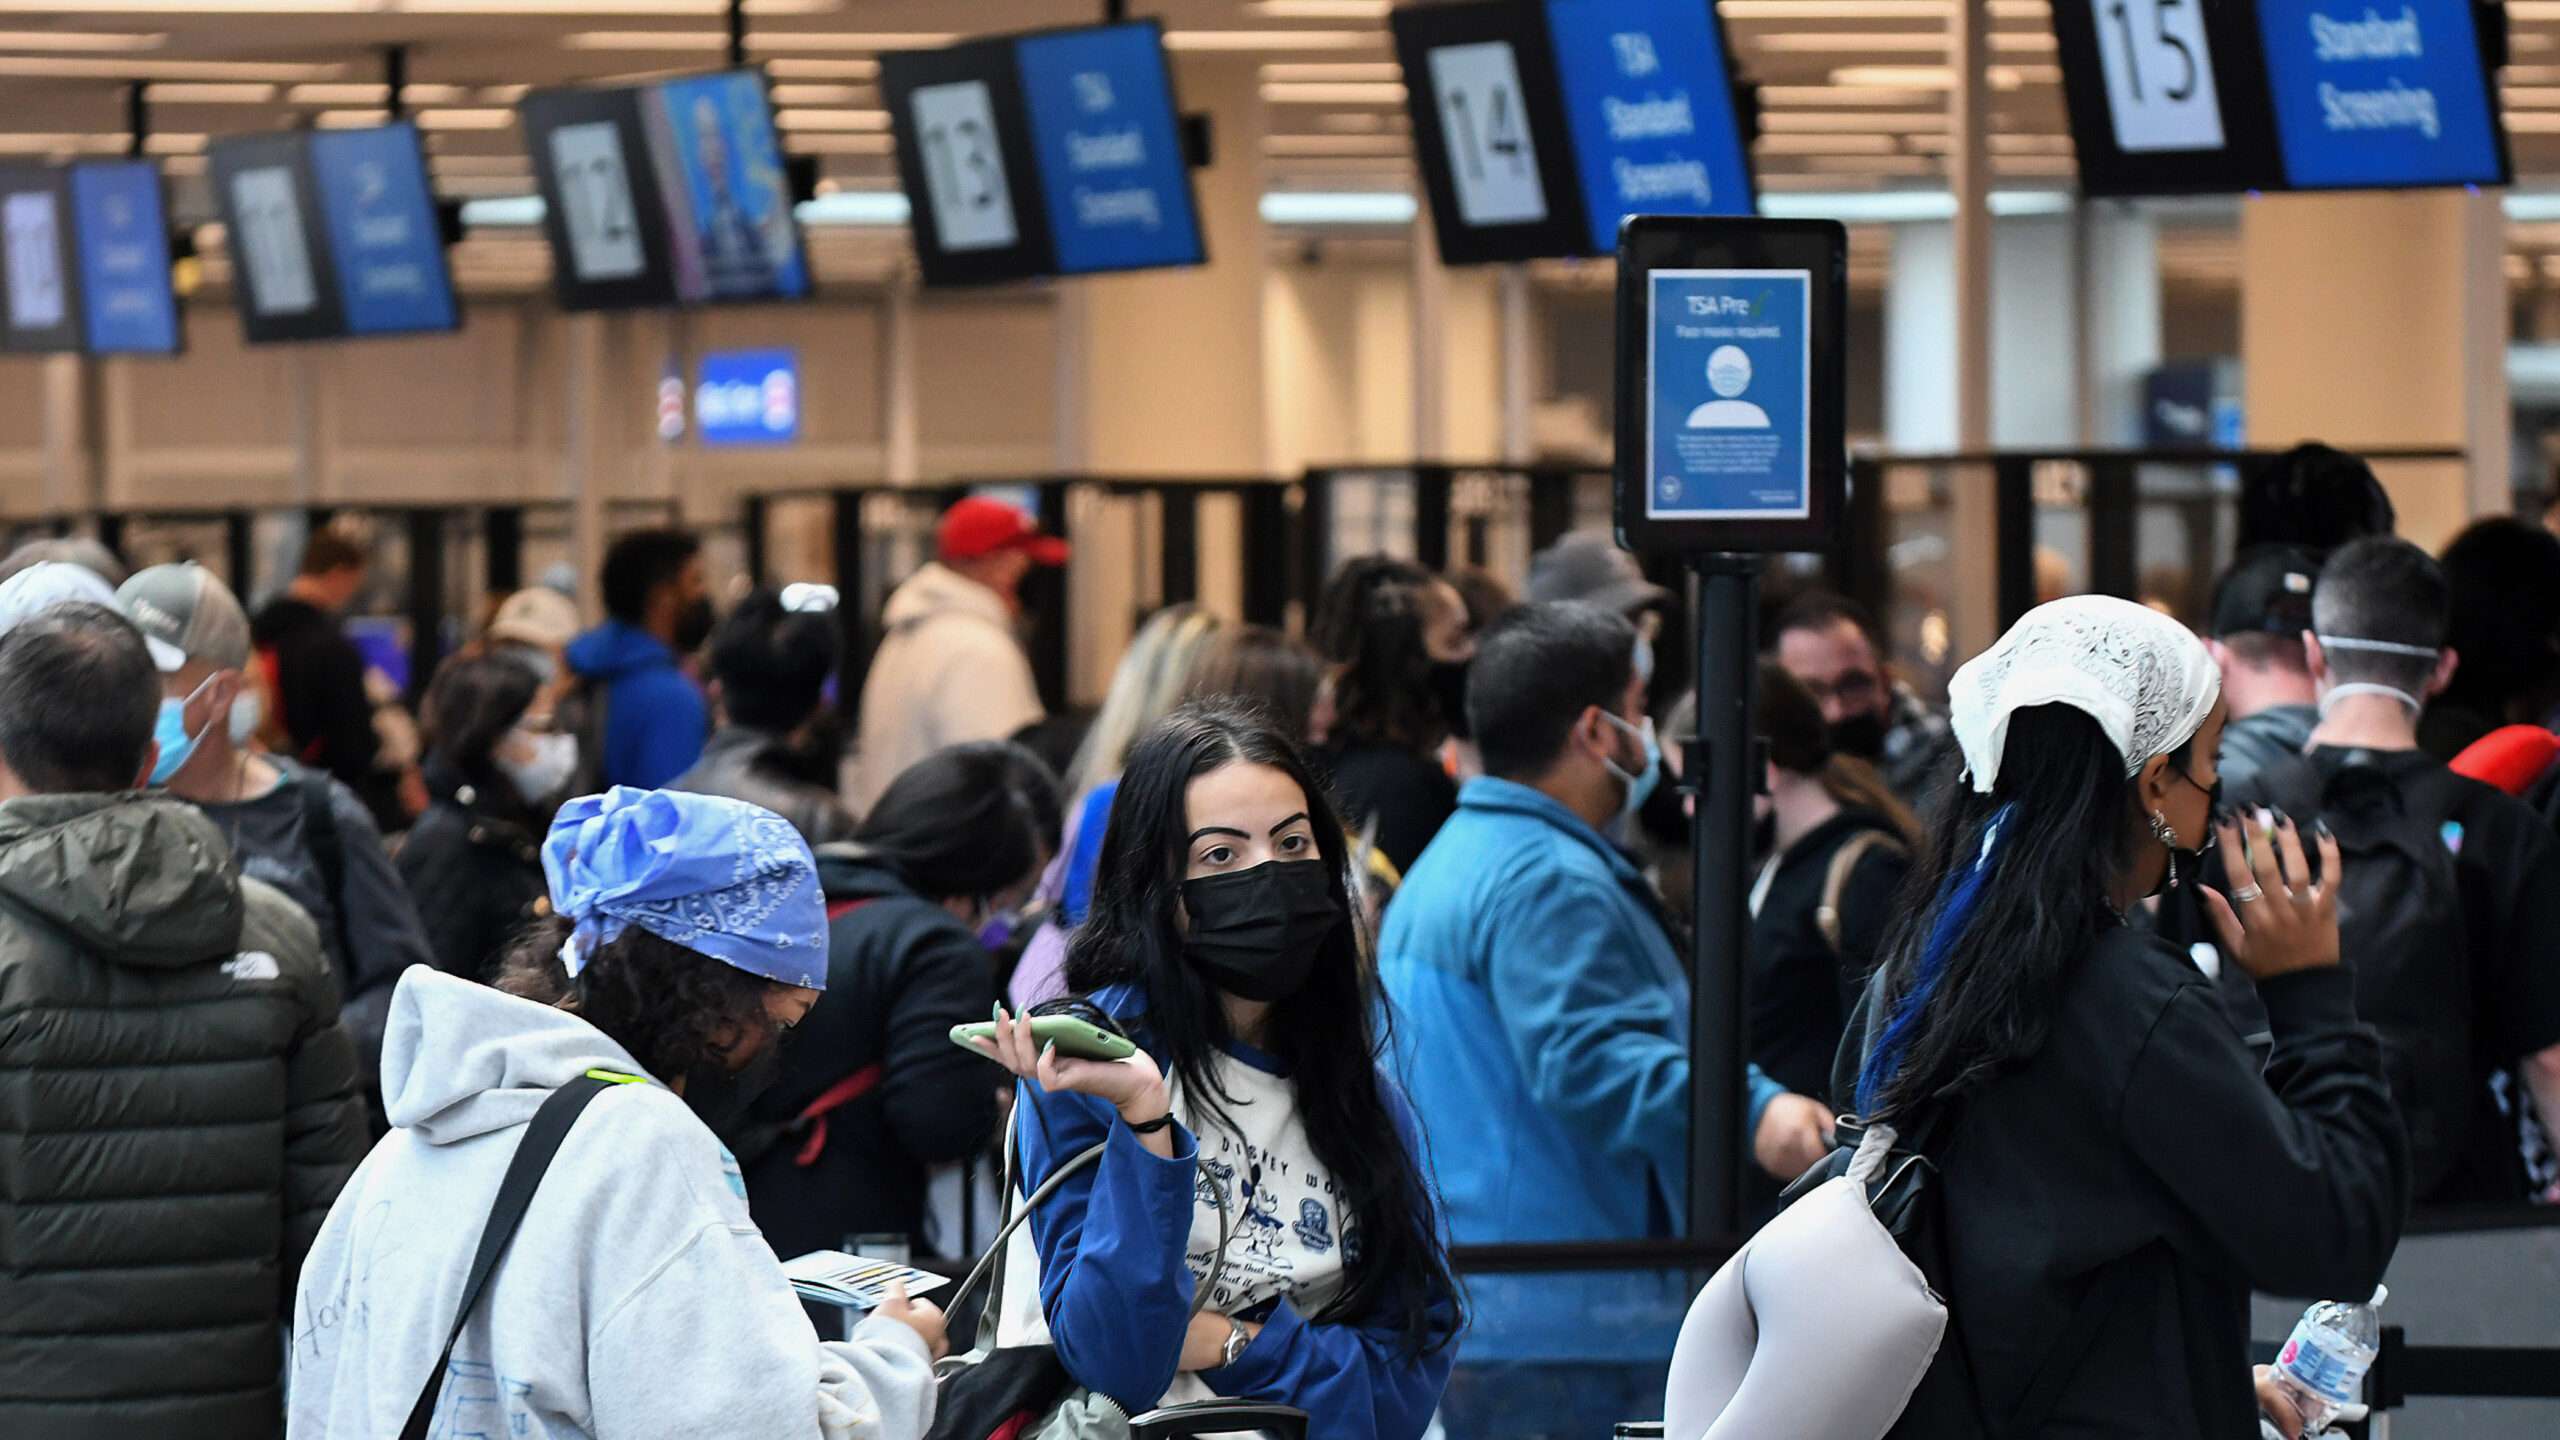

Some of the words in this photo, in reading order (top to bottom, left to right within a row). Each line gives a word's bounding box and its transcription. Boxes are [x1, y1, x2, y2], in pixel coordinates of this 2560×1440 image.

[2106, 0, 2195, 103] 15
[2310, 8, 2423, 61] Standard
[1448, 84, 1527, 181] 14
[1603, 89, 1695, 141] Standard
[2316, 77, 2441, 139] Screening
[1612, 150, 1713, 207] Screening
[1685, 295, 1719, 316] TSA
[1720, 295, 1751, 316] Pre
